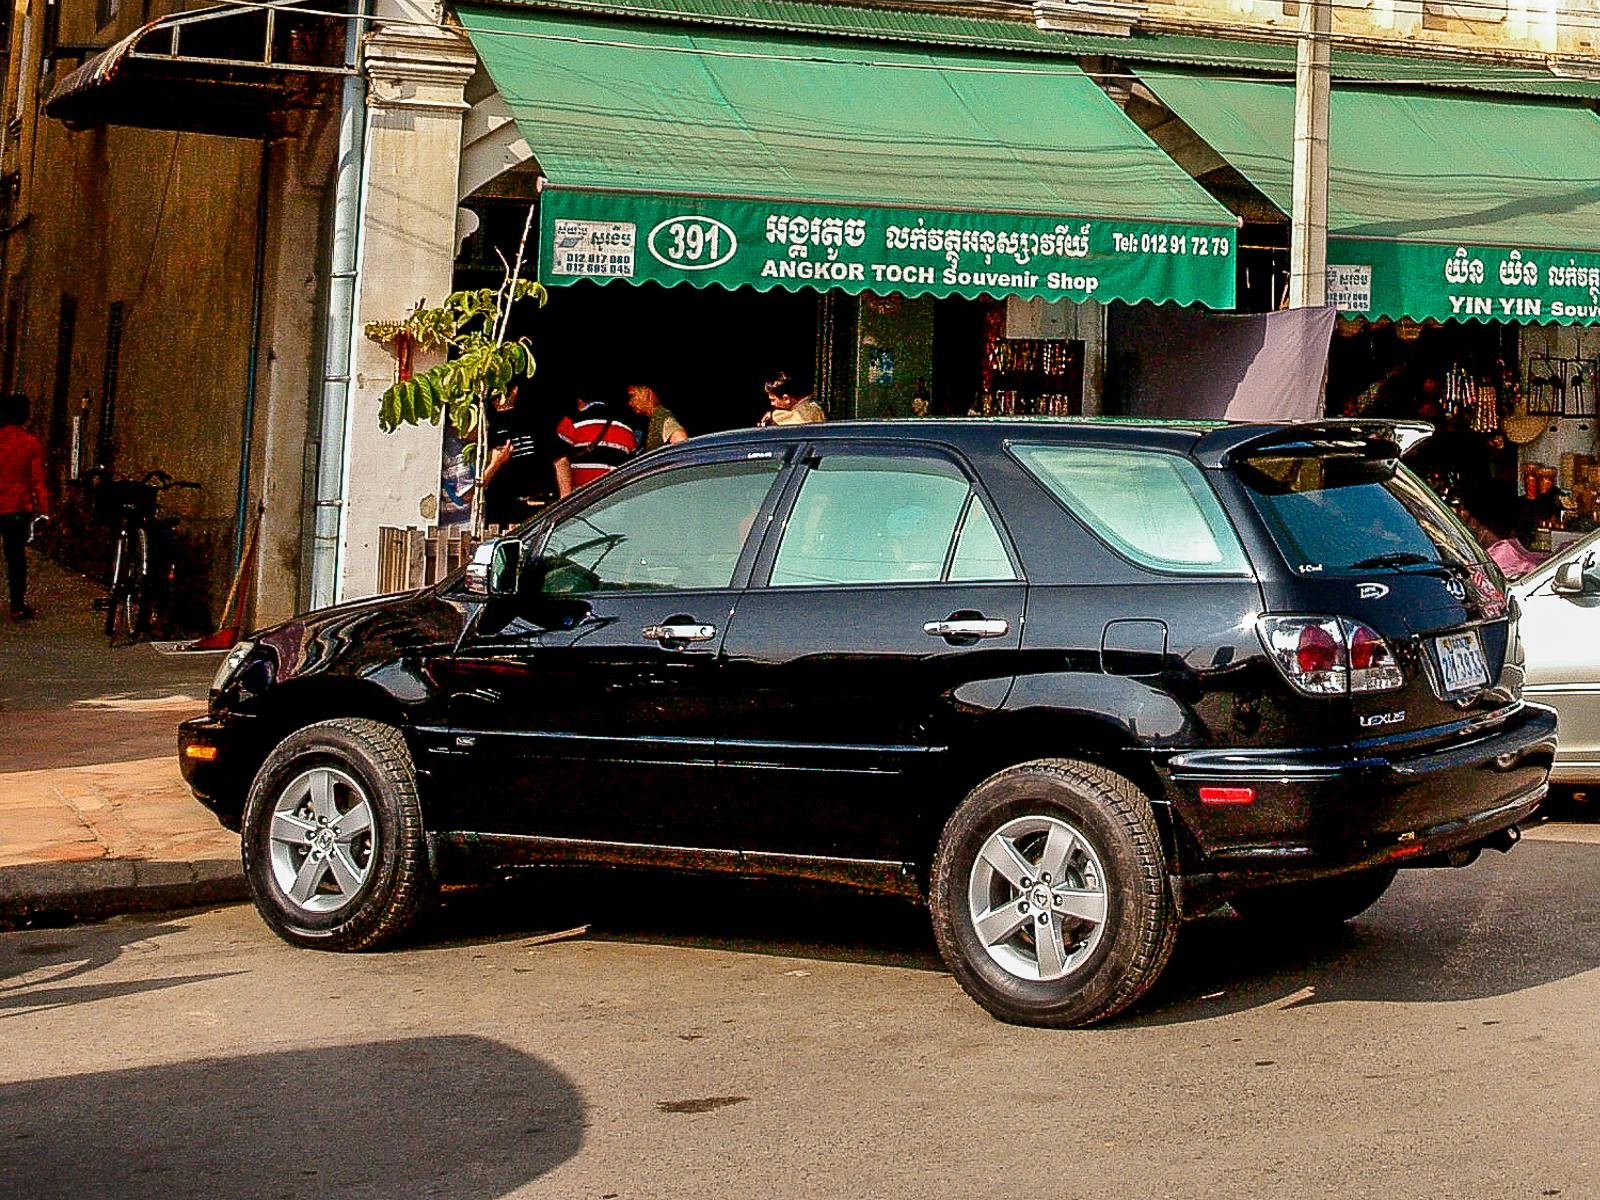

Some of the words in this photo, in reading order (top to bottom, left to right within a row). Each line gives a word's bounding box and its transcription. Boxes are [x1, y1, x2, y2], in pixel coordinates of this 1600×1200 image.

[668, 223, 719, 260] 391
[1112, 232, 1139, 253] Tel:
[1141, 233, 1168, 254] 012
[1170, 234, 1186, 255] 91
[1191, 235, 1209, 256] 72
[1211, 236, 1229, 257] 79
[761, 259, 865, 281] ANGKOR
[871, 263, 935, 284] TOCH
[942, 267, 1039, 288] Souvenir
[1047, 271, 1098, 293] Shop
[1449, 295, 1492, 315] YIN
[1499, 297, 1541, 316] YIN
[1359, 711, 1406, 728] LEXUS
